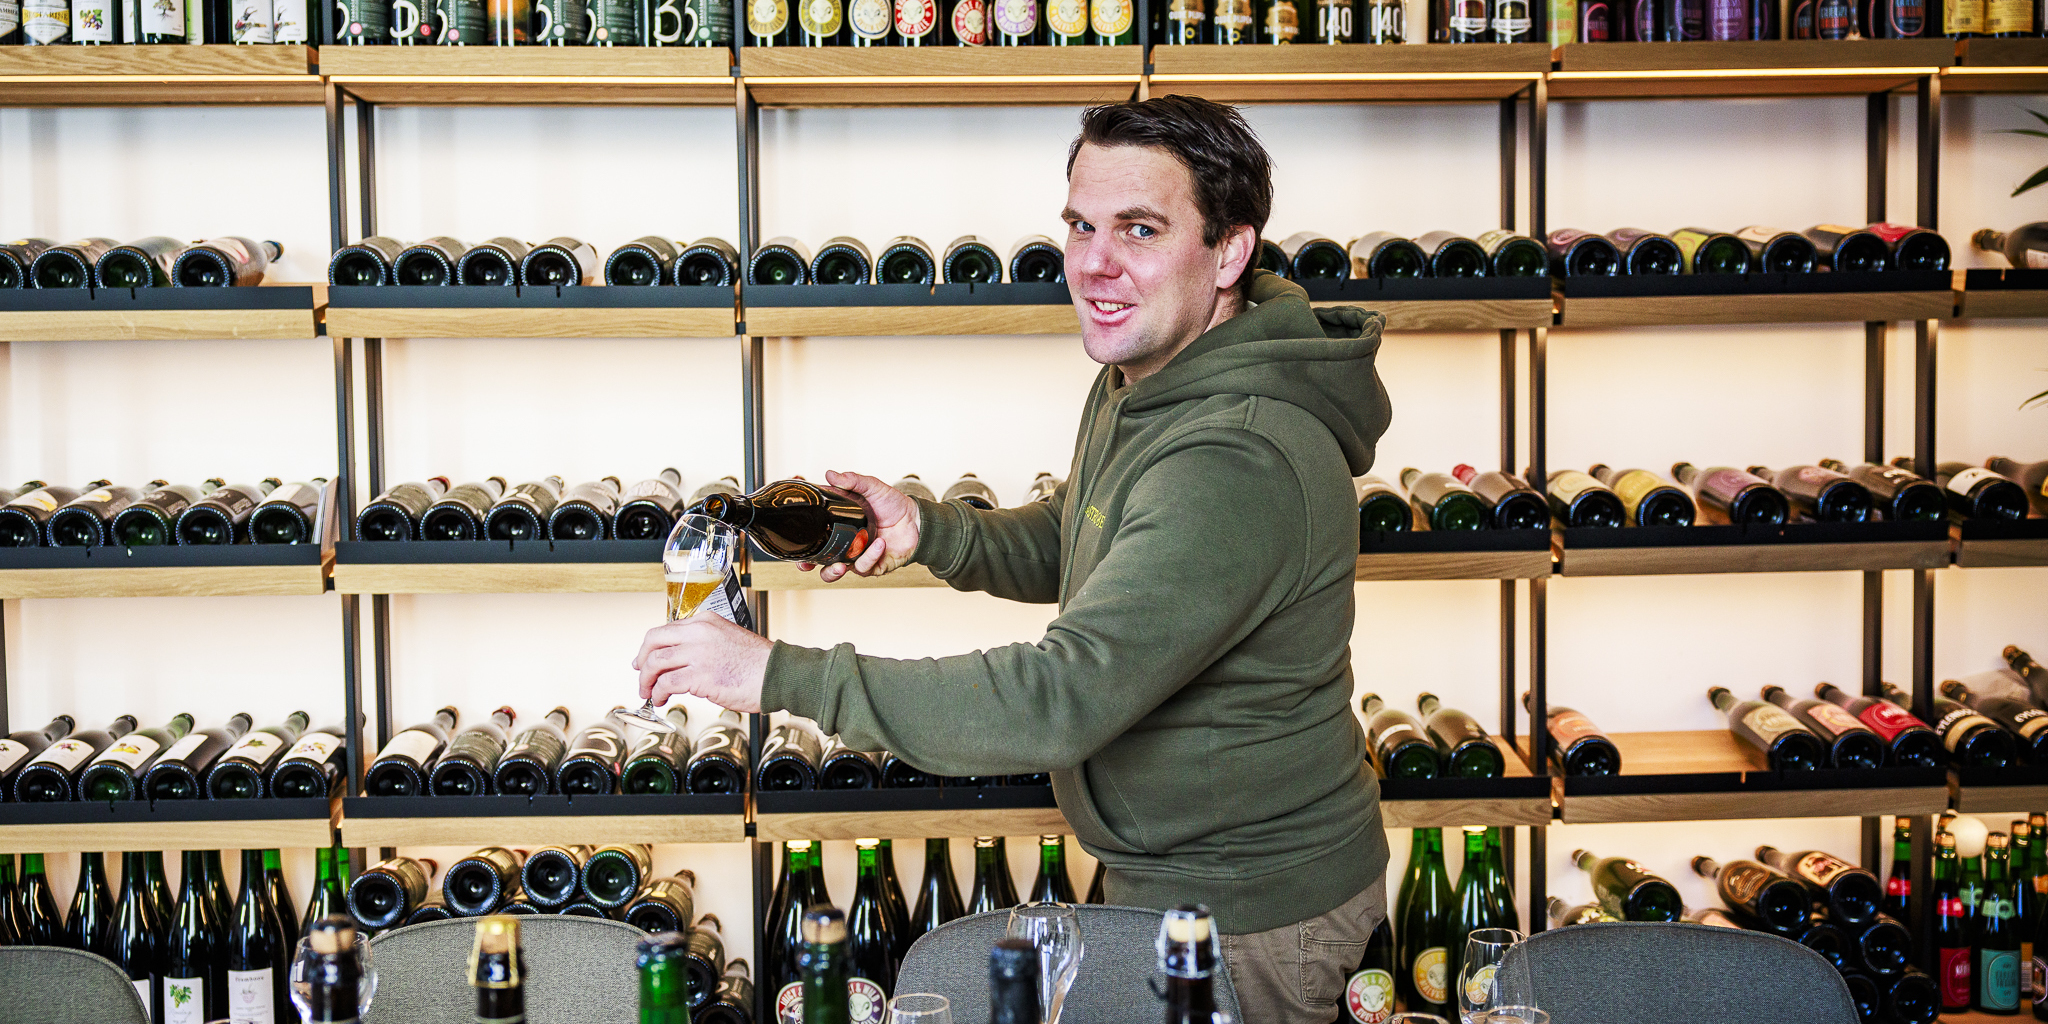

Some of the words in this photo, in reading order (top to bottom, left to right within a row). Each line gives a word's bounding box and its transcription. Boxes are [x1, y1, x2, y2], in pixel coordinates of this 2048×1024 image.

[24, 10, 69, 21] NECTARINE
[1318, 7, 1353, 37] 140
[1371, 6, 1401, 37] 140
[780, 988, 796, 1006] JUICY
[863, 984, 881, 1003] WILD
